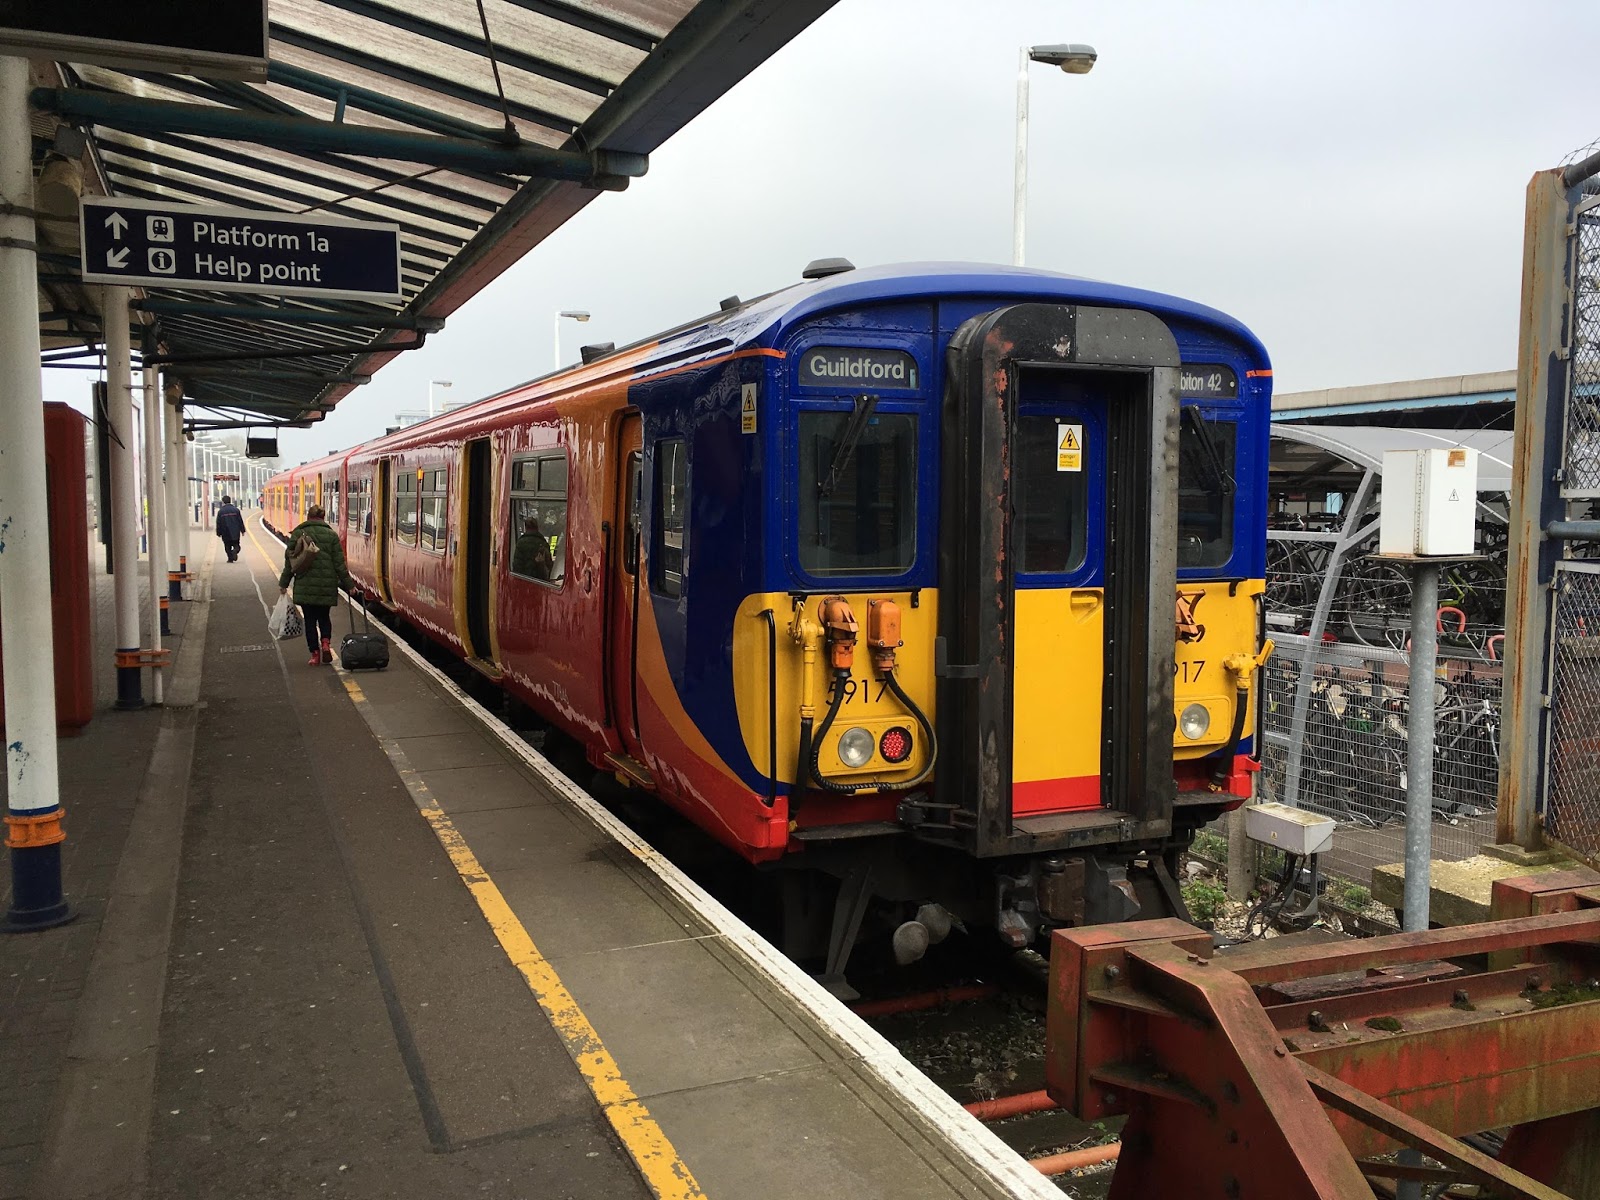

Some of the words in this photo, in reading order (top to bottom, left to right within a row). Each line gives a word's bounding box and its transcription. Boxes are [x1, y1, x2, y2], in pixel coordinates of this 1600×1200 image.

[193, 221, 300, 251] Platform
[306, 231, 330, 253] 1a
[194, 253, 252, 281] Help
[259, 260, 322, 283] point
[810, 355, 905, 380] Guildford
[1207, 373, 1222, 391] 42
